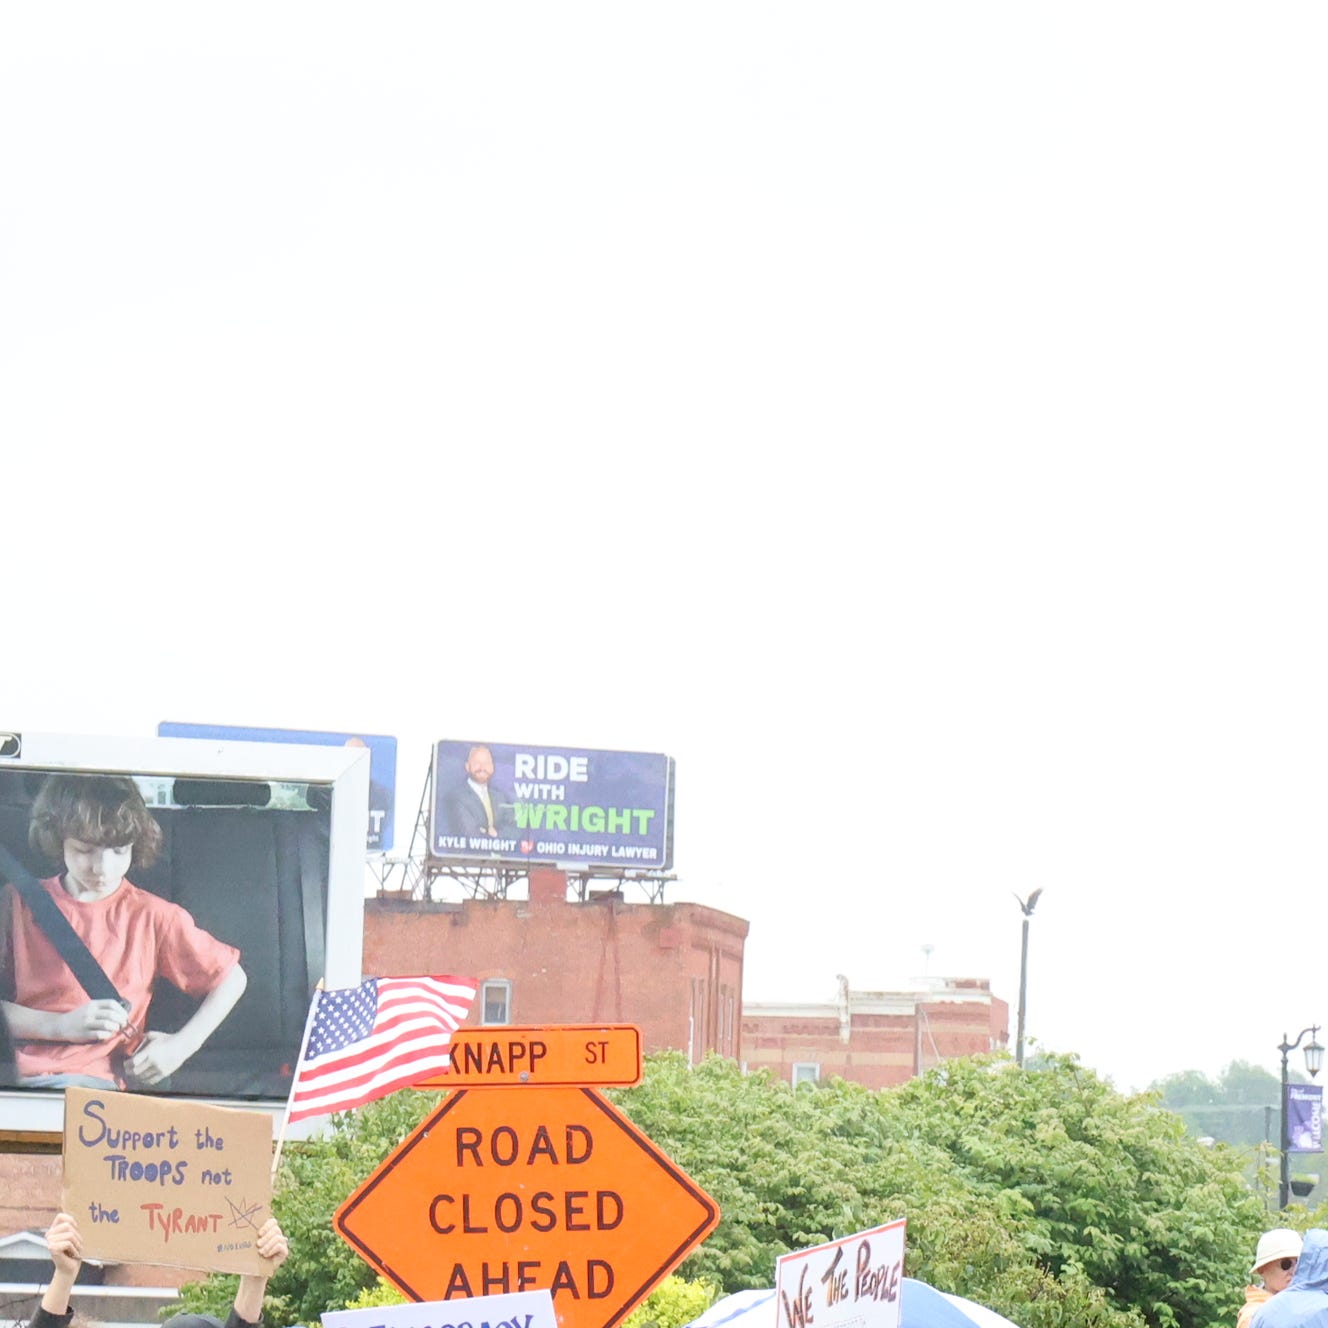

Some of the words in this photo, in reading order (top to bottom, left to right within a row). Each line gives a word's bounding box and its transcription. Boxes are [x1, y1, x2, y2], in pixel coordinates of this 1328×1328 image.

[514, 754, 588, 783] RIDE
[513, 782, 565, 801] WITH
[513, 802, 655, 836] WRIGHT
[438, 836, 466, 849] KYLE
[469, 838, 516, 852] WRIGHT
[536, 843, 566, 855] OHIO
[567, 843, 609, 858] INJURY
[611, 845, 658, 860] LAWYER
[445, 1041, 547, 1075] KNAPP
[584, 1041, 609, 1065] ST
[78, 1099, 180, 1150] Support
[195, 1126, 224, 1150] the
[456, 1124, 594, 1168] ROAD
[103, 1154, 188, 1186] TROOPS
[201, 1168, 232, 1185] not
[88, 1201, 120, 1223] the
[428, 1190, 624, 1234] CLOSED
[443, 1259, 615, 1300] AHEAD
[854, 1239, 901, 1303] PEOPLE
